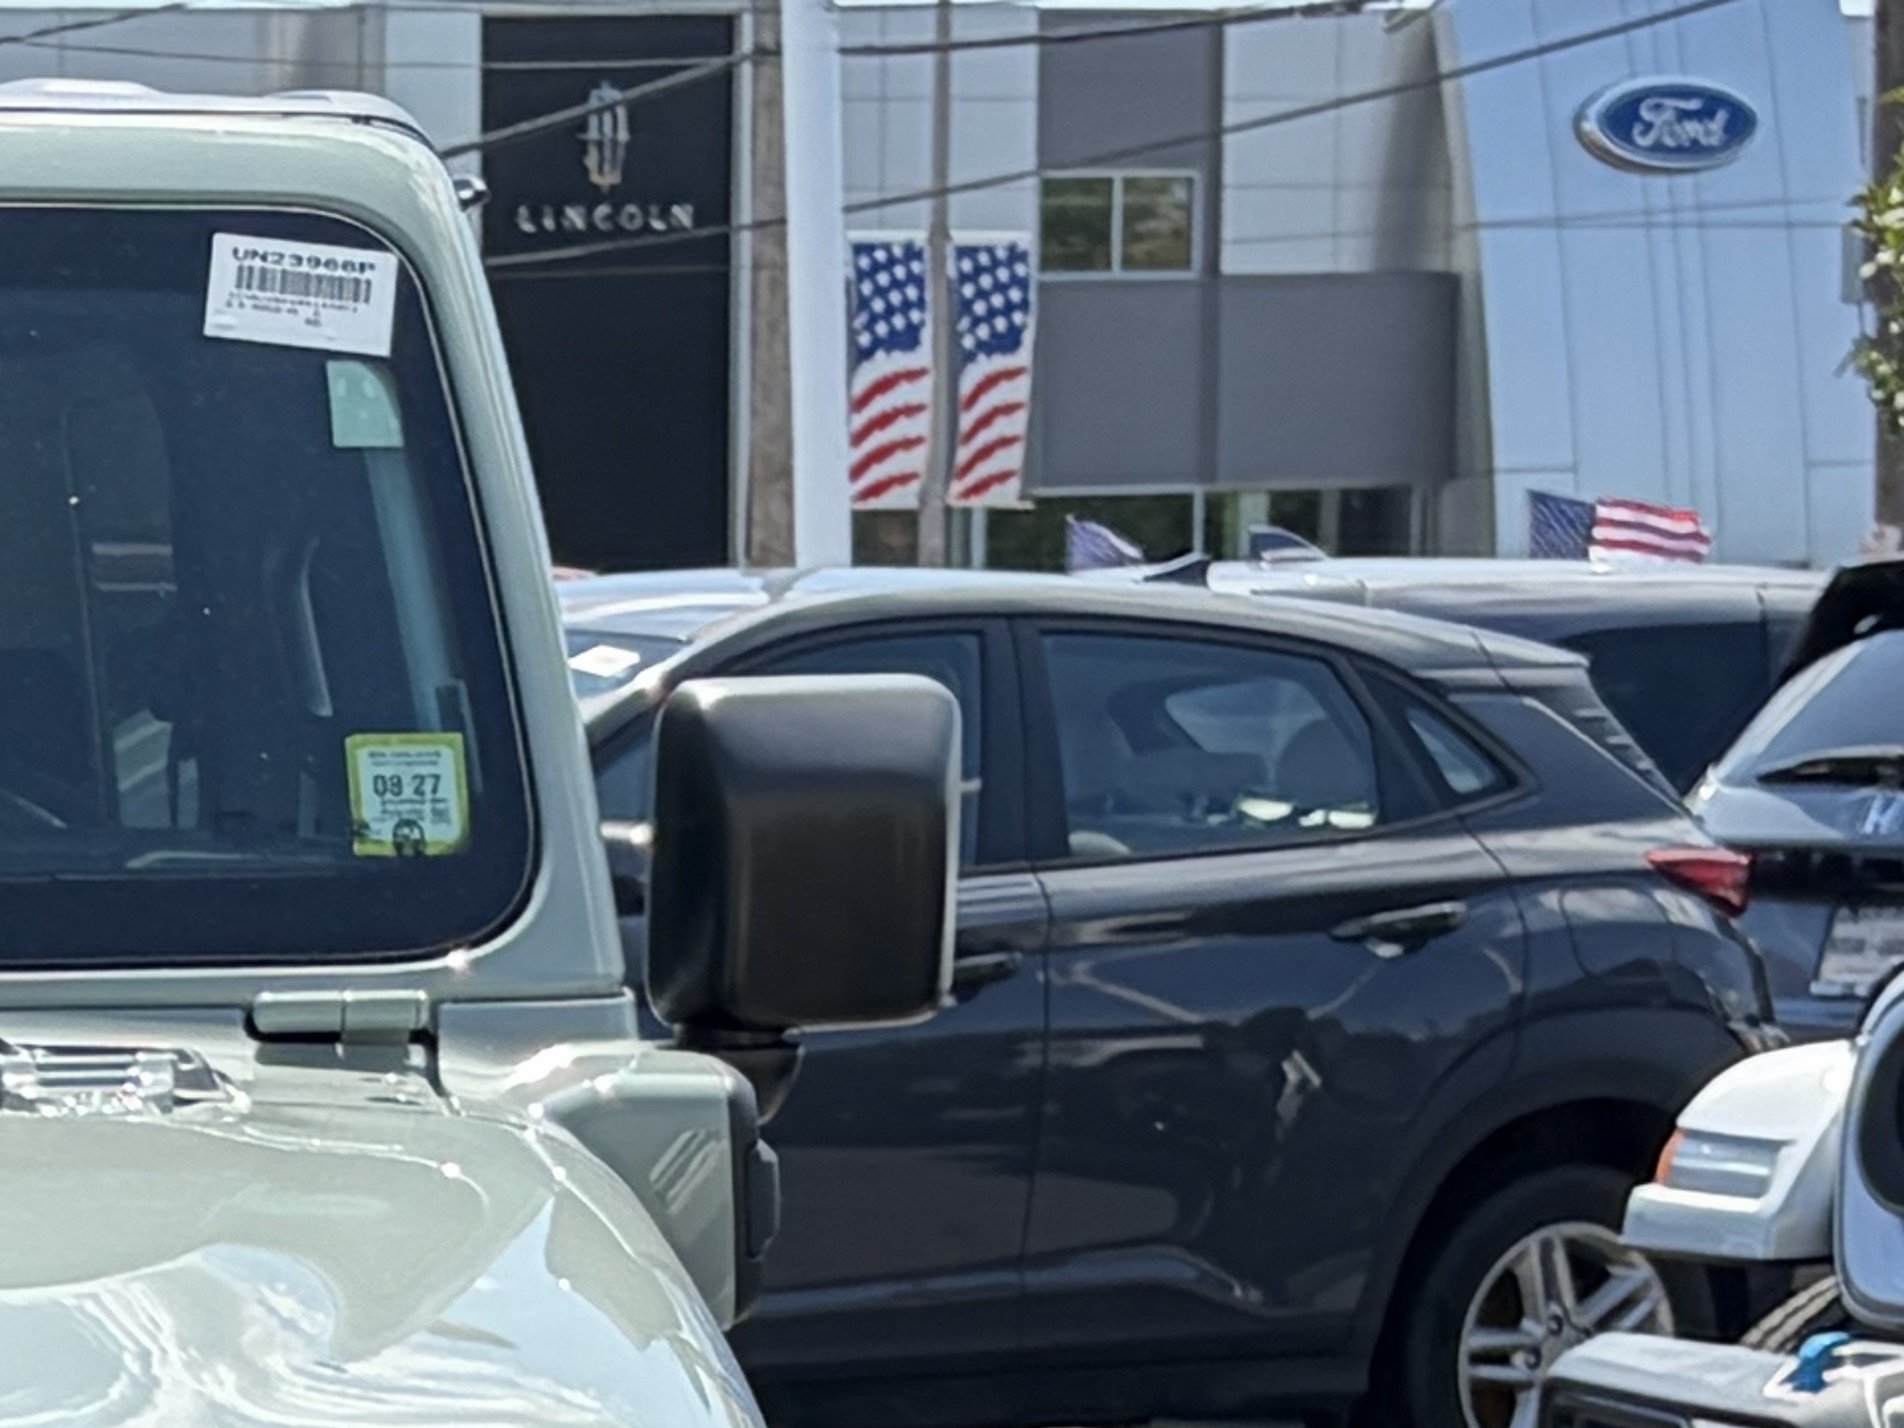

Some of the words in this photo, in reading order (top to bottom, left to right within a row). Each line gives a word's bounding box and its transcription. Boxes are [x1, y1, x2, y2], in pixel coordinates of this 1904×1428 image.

[1632, 97, 1729, 147] Ford
[516, 203, 694, 233] LINCOLN
[411, 773, 441, 796] 27
